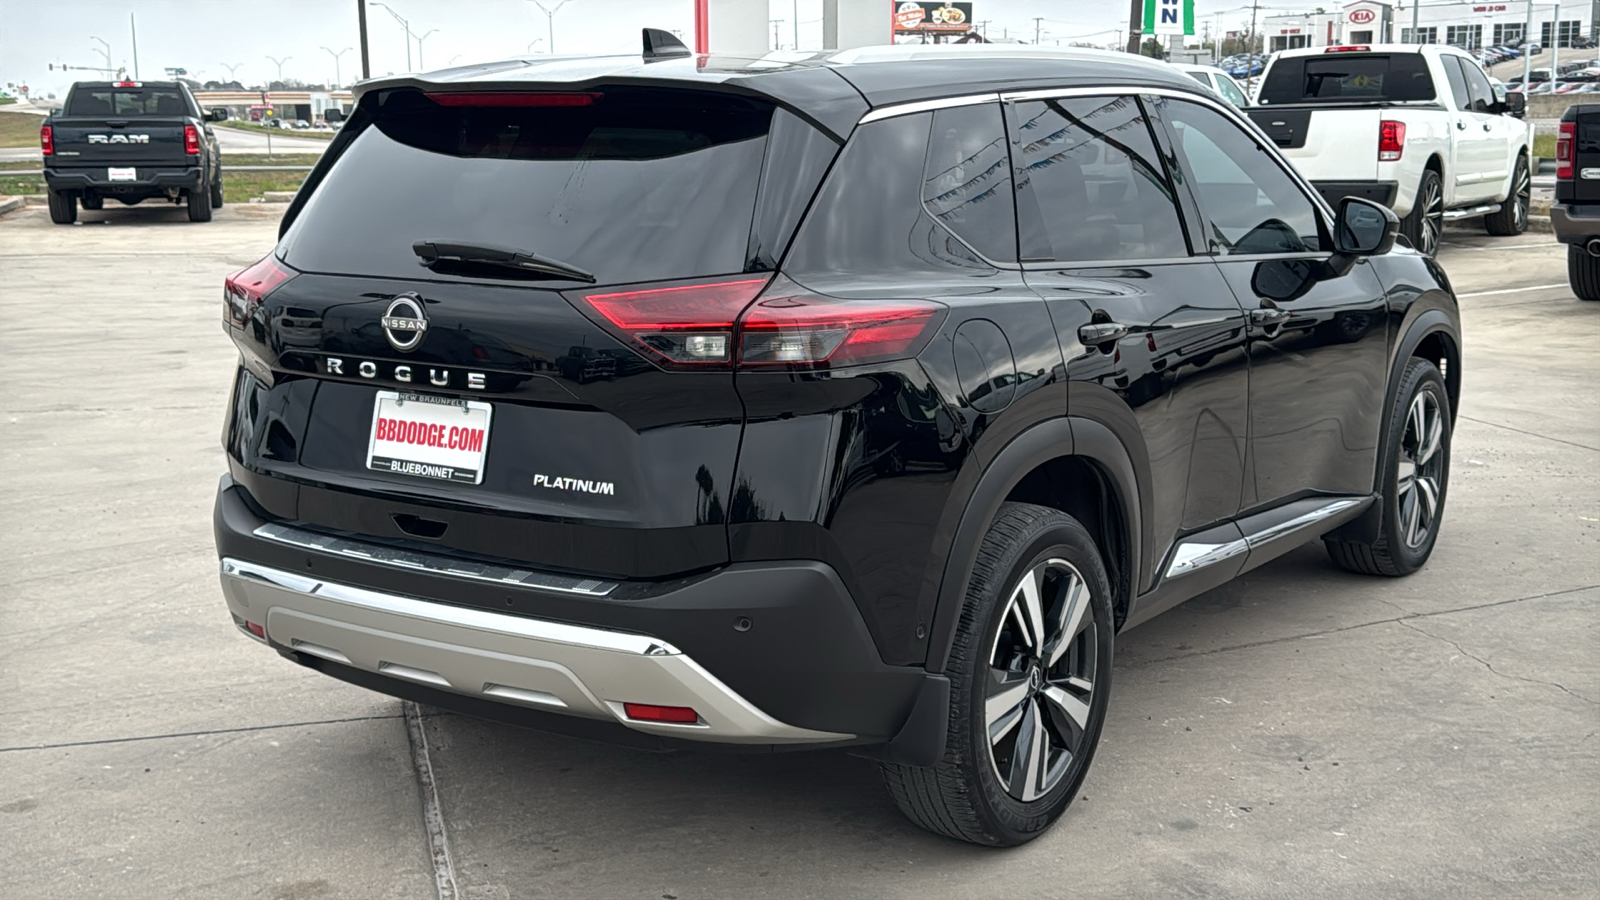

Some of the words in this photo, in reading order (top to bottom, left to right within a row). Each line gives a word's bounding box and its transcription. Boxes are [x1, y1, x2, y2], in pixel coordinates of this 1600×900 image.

[1353, 12, 1371, 21] KIA
[88, 134, 149, 144] RAM
[382, 318, 426, 330] NISSAN
[327, 357, 486, 389] ROGUE
[400, 393, 418, 402] NEW
[419, 396, 467, 407] BRAUNFELS
[376, 417, 484, 453] BBDODGE.COM
[391, 460, 454, 479] BLUEBONNET
[533, 473, 614, 495] PLATINUM
